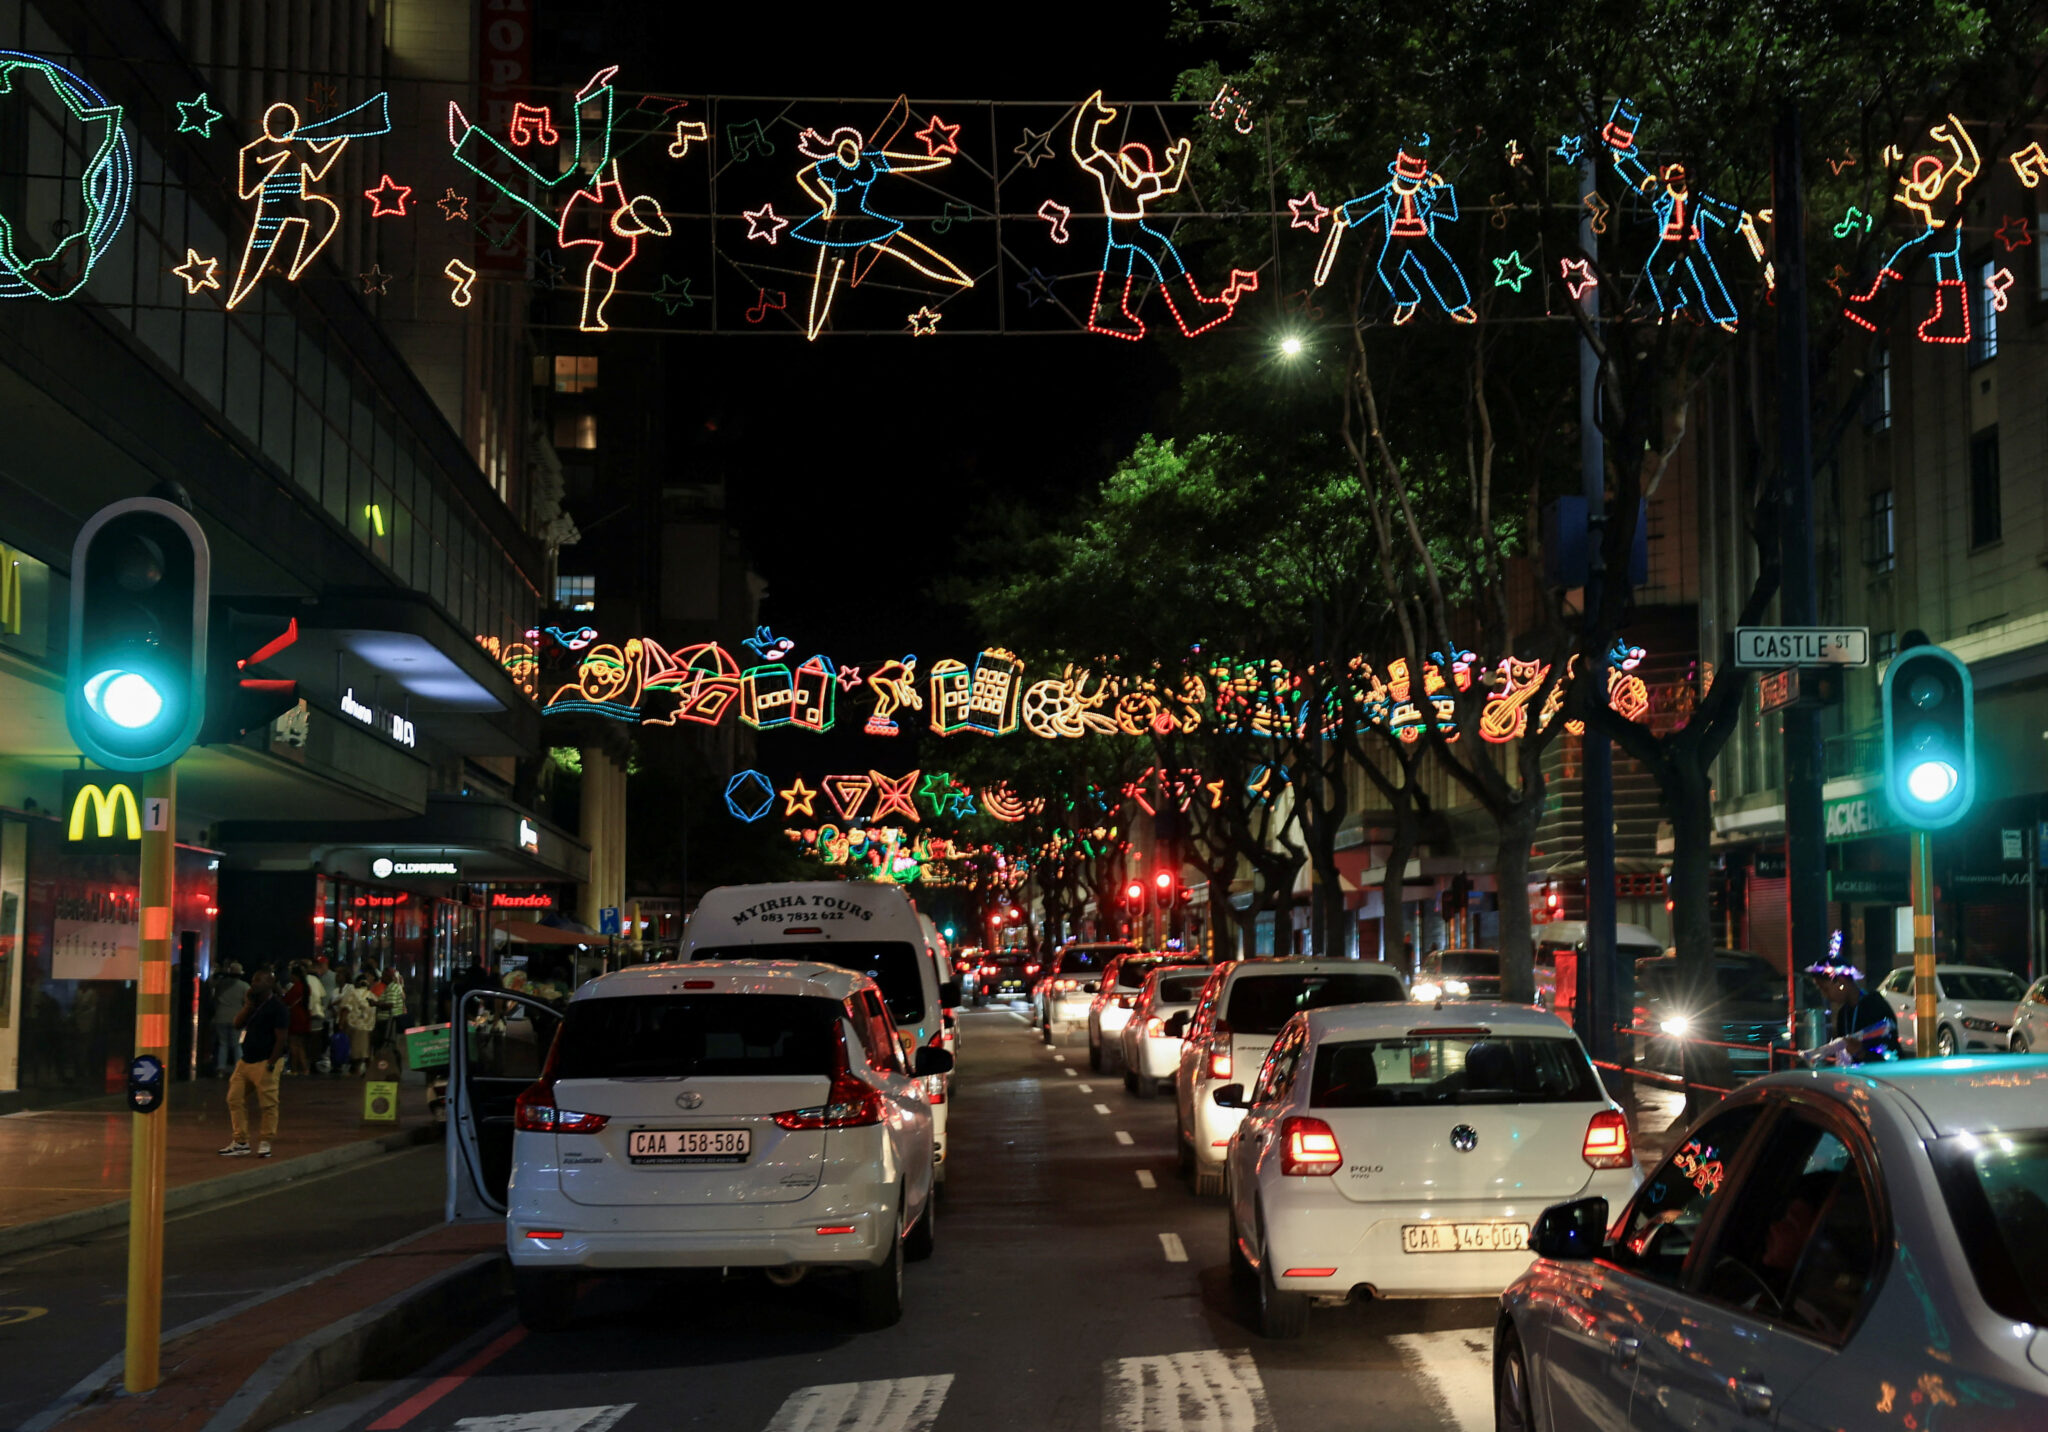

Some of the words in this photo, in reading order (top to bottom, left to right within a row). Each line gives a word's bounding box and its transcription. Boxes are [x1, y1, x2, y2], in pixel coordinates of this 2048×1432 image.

[1753, 635, 1828, 658] CASTLE
[1834, 634, 1851, 649] ST
[151, 803, 160, 826] 1
[1825, 799, 1880, 838] ACKER
[492, 893, 553, 908] Nando's
[731, 895, 807, 927] MYIRHA
[812, 895, 874, 922] TOURS
[604, 909, 615, 921] P
[760, 912, 784, 923] 083
[787, 911, 818, 923] 7832
[821, 910, 845, 921] 622
[637, 1134, 667, 1154] CAA
[677, 1133, 746, 1153] 158-586
[1350, 1165, 1384, 1173] POLO
[1408, 1226, 1441, 1249] CAA
[1453, 1224, 1522, 1249] 146-006
